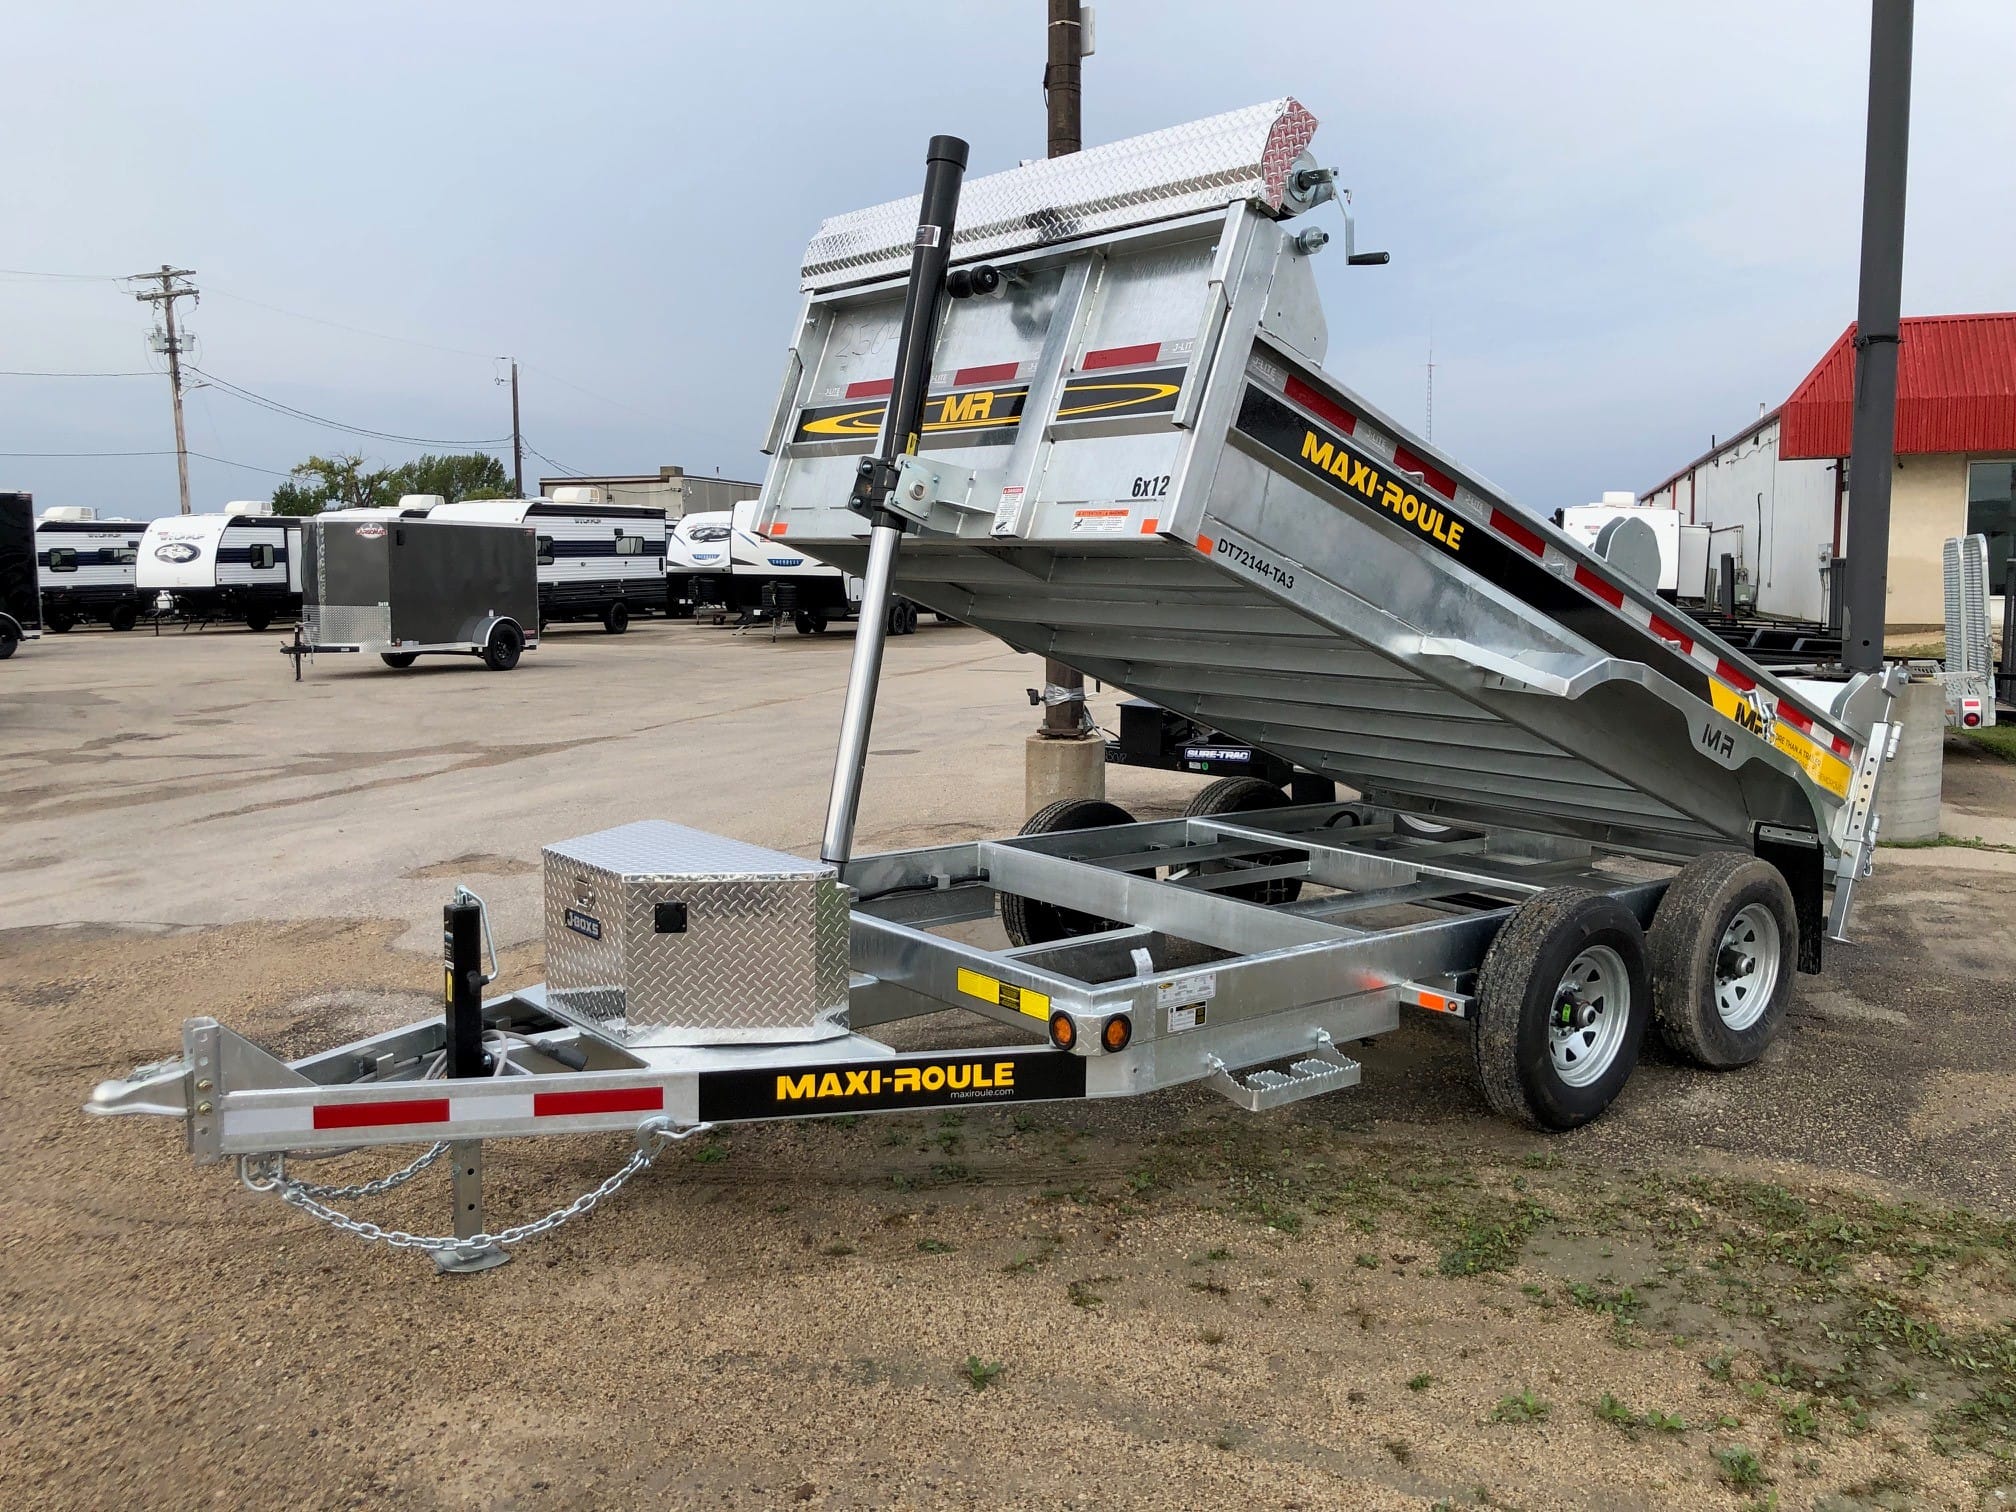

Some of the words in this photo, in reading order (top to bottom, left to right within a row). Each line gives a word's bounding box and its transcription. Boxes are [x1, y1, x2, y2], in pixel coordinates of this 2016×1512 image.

[940, 391, 994, 422] MR
[1132, 475, 1170, 497] 6x12
[1300, 430, 1465, 551] MAXI-ROULE
[1218, 538, 1294, 589] DT72144-TA3
[1187, 750, 1248, 759] SURE-TRAC
[1702, 723, 1734, 759] MR
[776, 1062, 1015, 1100] MAXI-ROULE
[950, 1088, 1014, 1099] maxiroule.com
